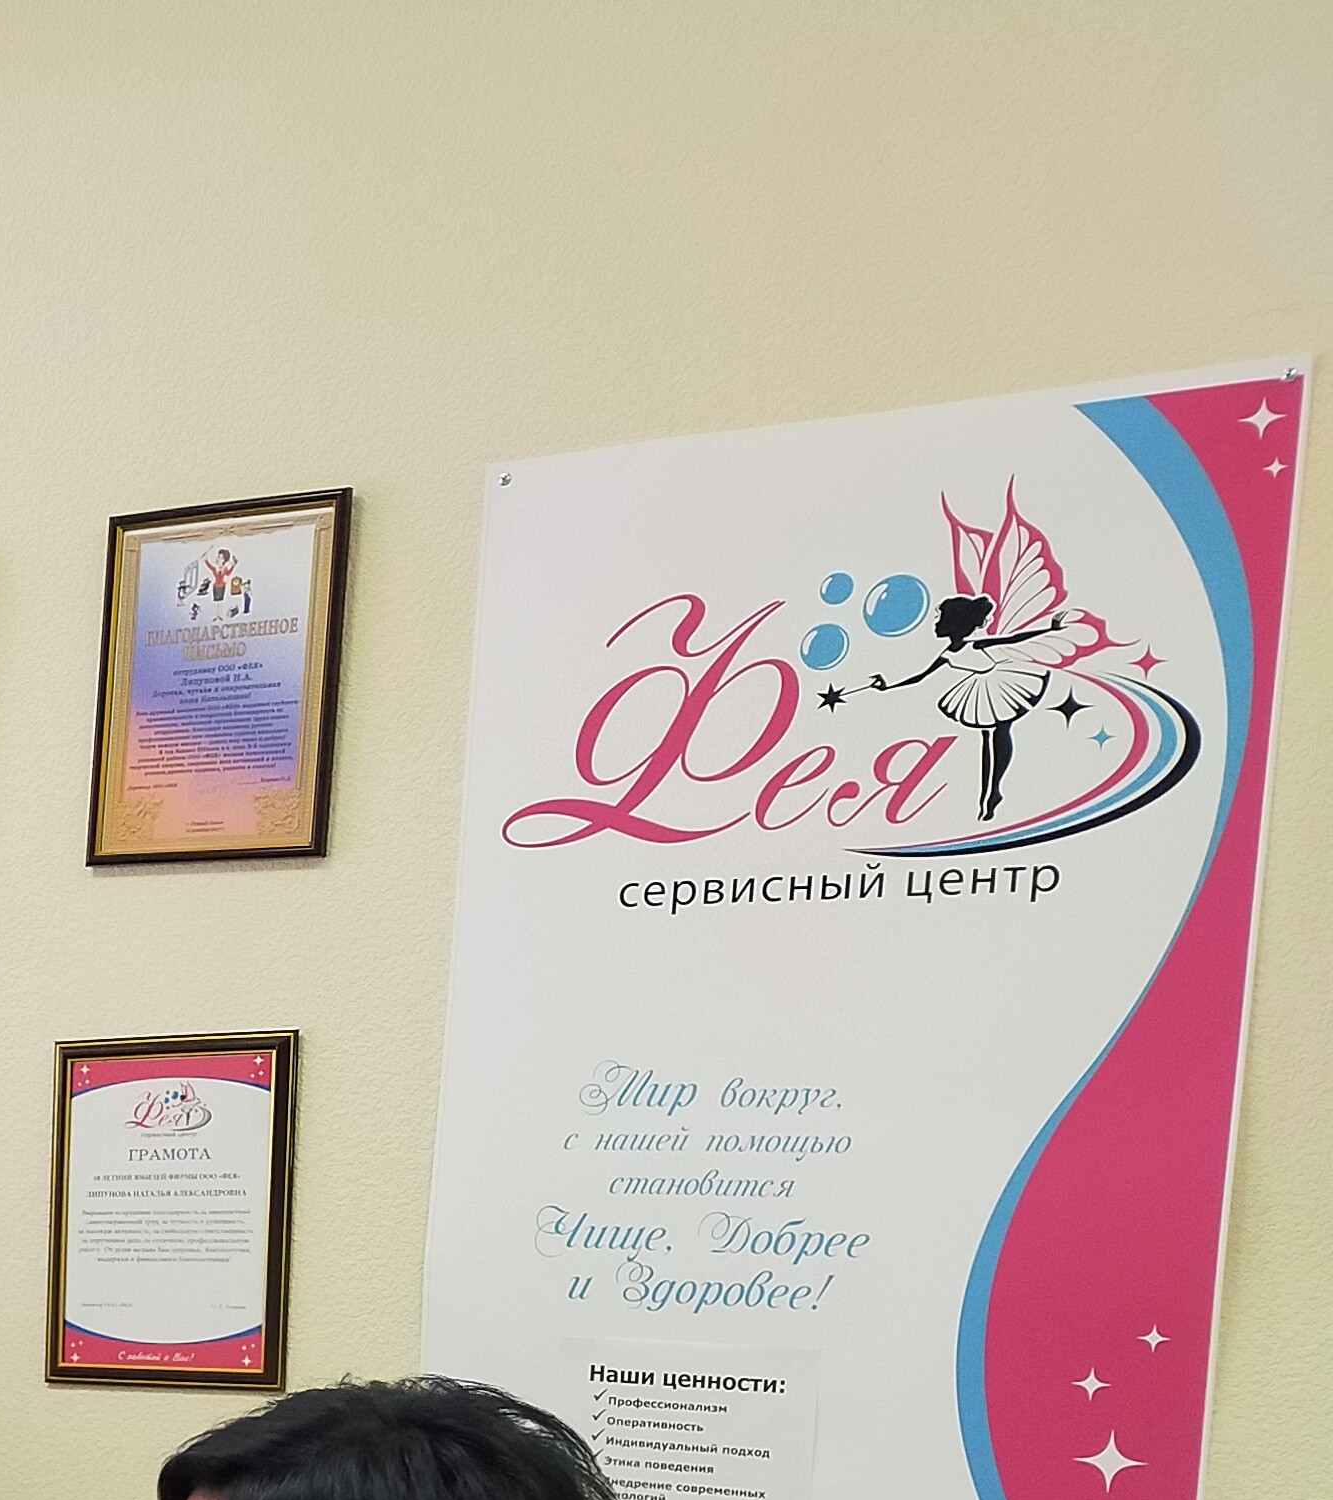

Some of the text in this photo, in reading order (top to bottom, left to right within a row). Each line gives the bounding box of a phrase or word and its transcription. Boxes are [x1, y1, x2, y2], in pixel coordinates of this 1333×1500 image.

[146, 617, 299, 647] БЛАГОДАРСТВЕННОЕ
[184, 641, 247, 661] ПИСЬМО
[218, 664, 235, 672] ООО
[500, 593, 960, 850] Фея
[619, 861, 1062, 915] сервисный центр
[579, 1060, 698, 1116] Мир
[128, 1148, 212, 1162] ГРАМОТА
[563, 1125, 853, 1162] с нашей помощью
[87, 1190, 132, 1198] ЛИПУНОВА
[608, 1169, 796, 1199] становится
[535, 1205, 871, 1265] Чище, Добрее
[568, 1260, 836, 1315] и Здоровее!
[589, 1364, 786, 1394] Наши ценности:
[607, 1396, 728, 1413] Профессионализм
[606, 1416, 704, 1432] Оперативность
[605, 1436, 771, 1459] Индивидуальный подход
[603, 1456, 715, 1474] Этика поведения
[675, 1483, 766, 1499] современных
